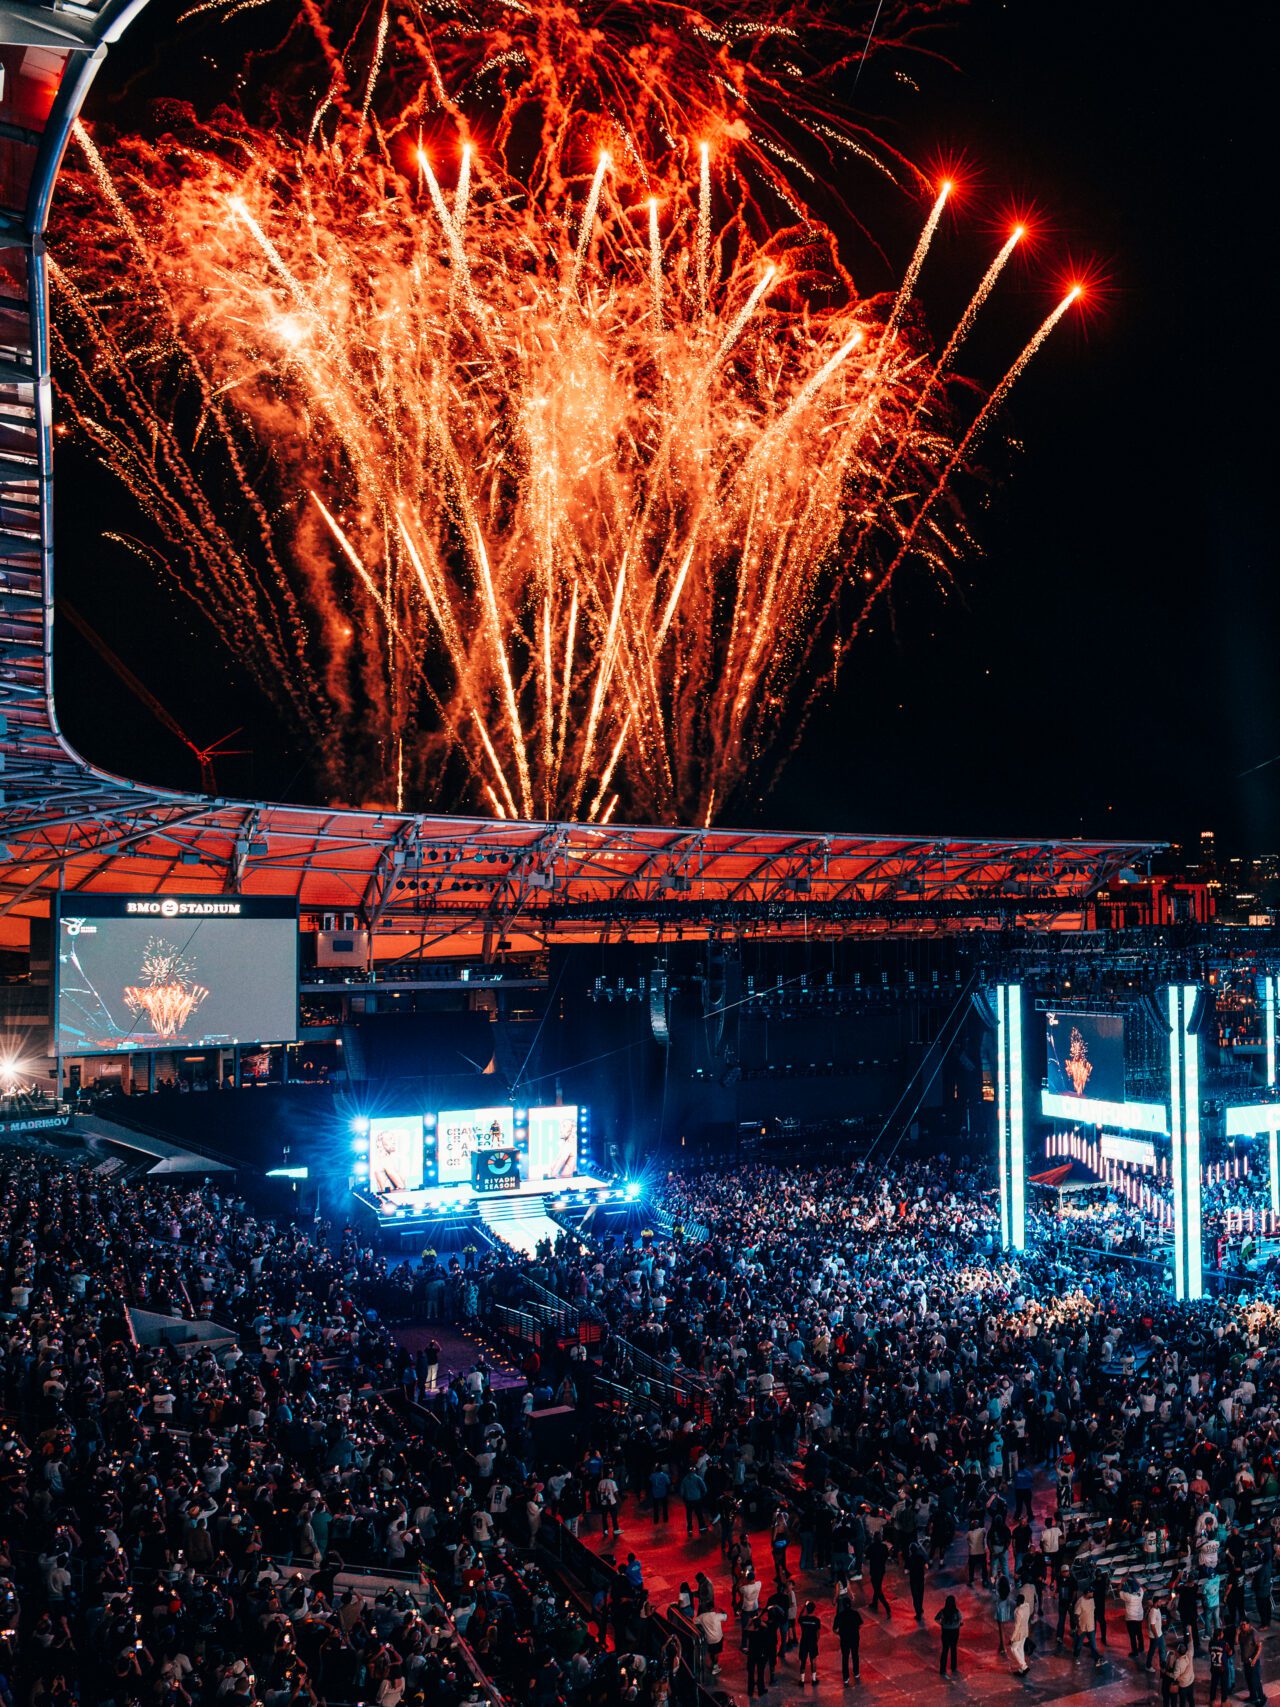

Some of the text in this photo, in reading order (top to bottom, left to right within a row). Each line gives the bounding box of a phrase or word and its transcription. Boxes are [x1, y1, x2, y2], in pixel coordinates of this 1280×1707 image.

[127, 903, 240, 914] BMO STADIUM
[10, 1116, 70, 1131] MADRIMOV
[484, 1177, 515, 1185] RIYADH
[1211, 1652, 1223, 1664] 27
